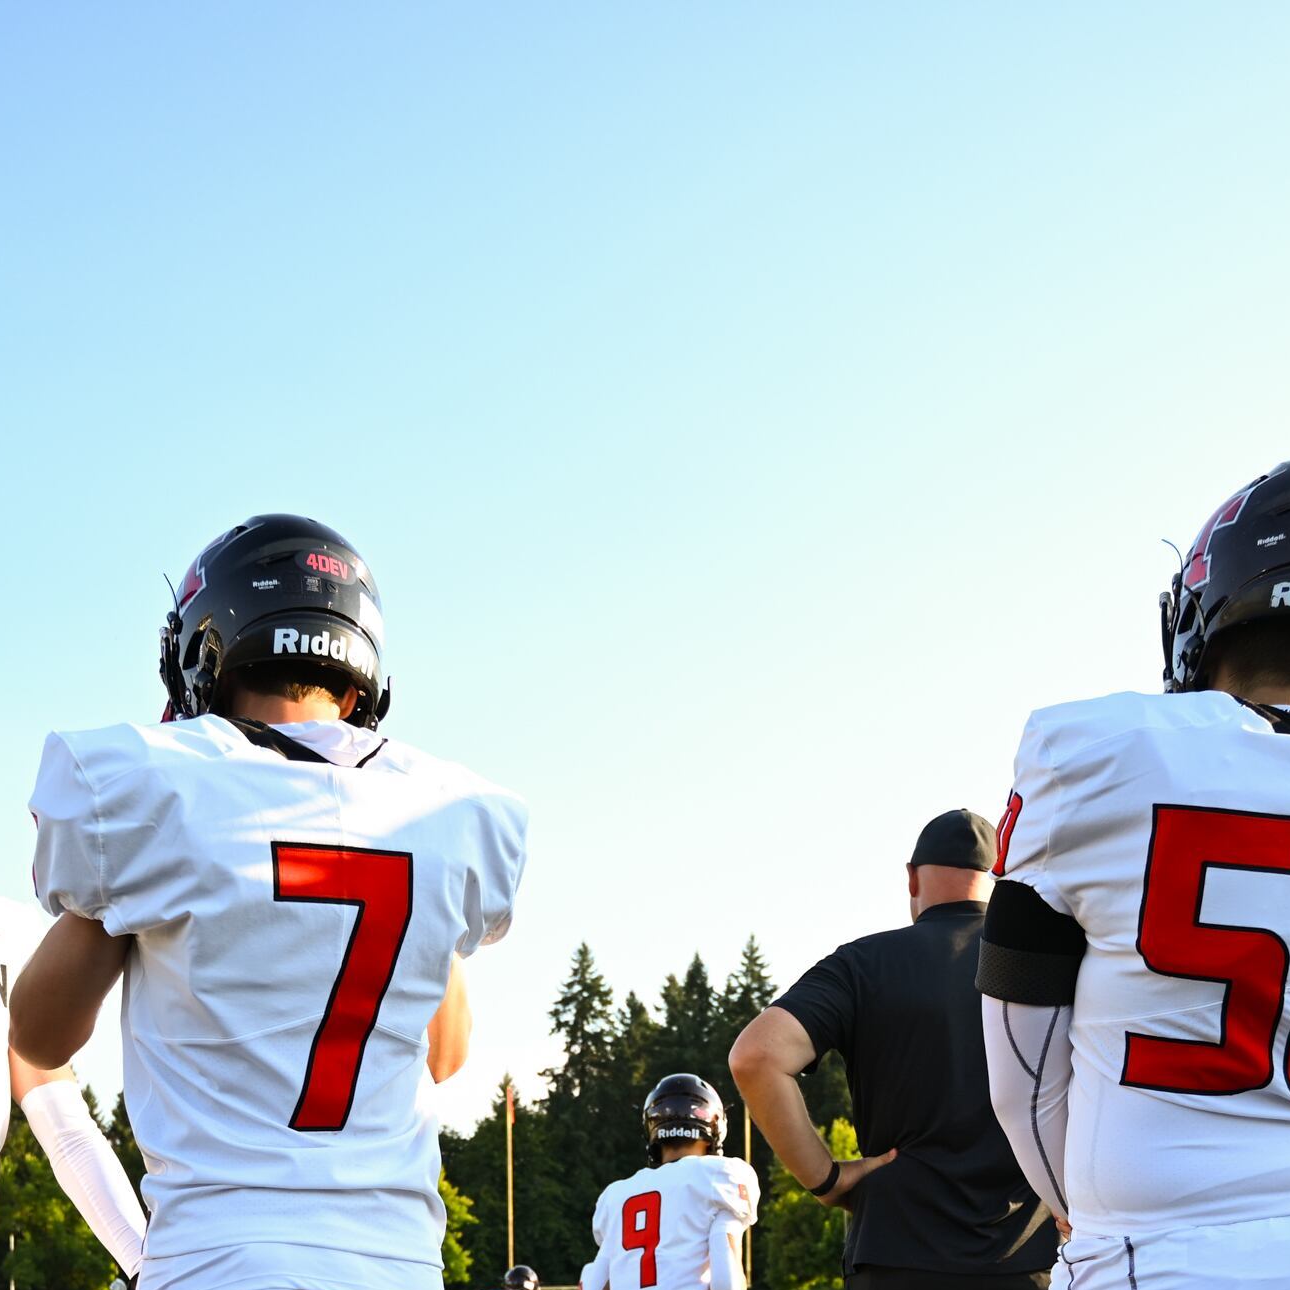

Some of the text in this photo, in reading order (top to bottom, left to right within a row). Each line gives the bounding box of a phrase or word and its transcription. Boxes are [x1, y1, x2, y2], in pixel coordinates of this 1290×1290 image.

[306, 553, 348, 580] 4DEV
[270, 839, 414, 1133] 7
[657, 1126, 701, 1139] Riddell
[621, 1190, 662, 1289] 9
